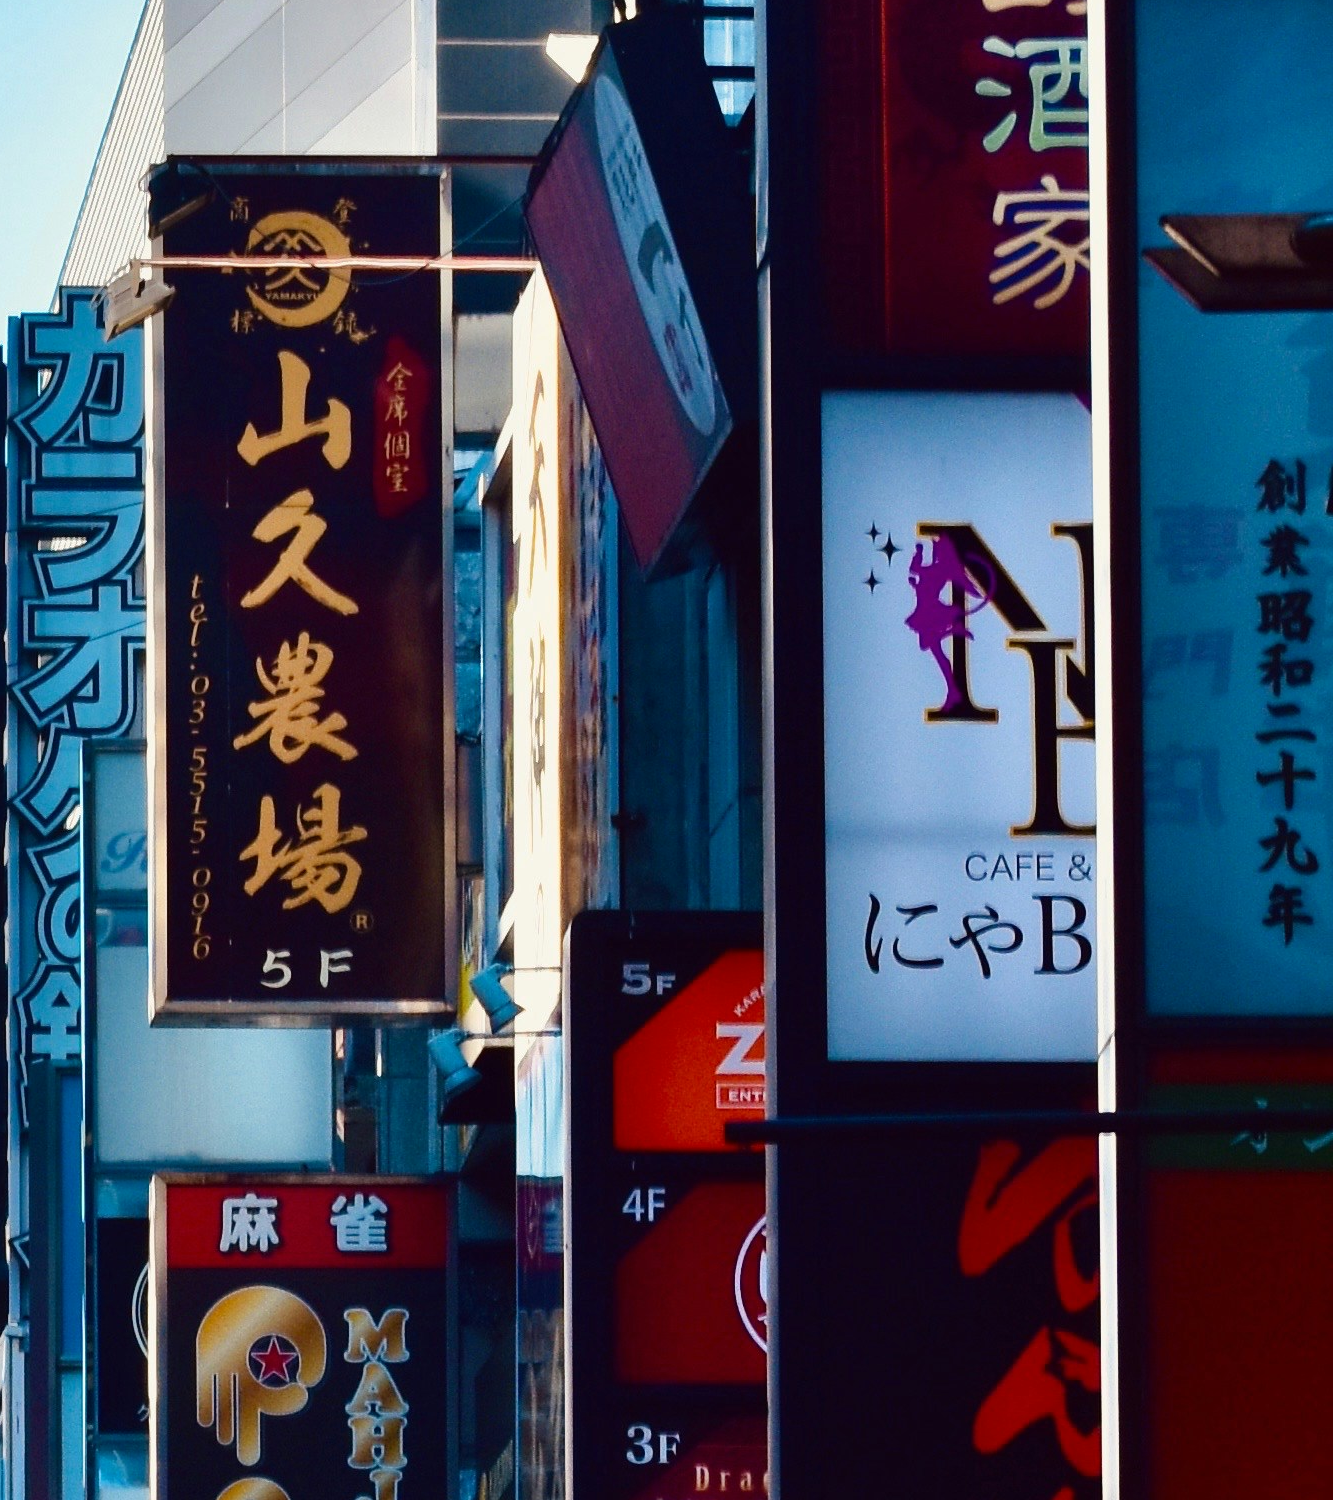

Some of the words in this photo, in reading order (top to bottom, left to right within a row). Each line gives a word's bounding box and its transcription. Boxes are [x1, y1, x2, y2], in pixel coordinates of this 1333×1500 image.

[233, 347, 368, 915] 山久農場
[1254, 457, 1320, 948] 創業昭和二十九年
[964, 853, 1055, 883] CAFE
[620, 963, 677, 996] 5F
[218, 1194, 392, 1256] 麻雀
[621, 1187, 666, 1223] 4F
[625, 1424, 682, 1465] 3F
